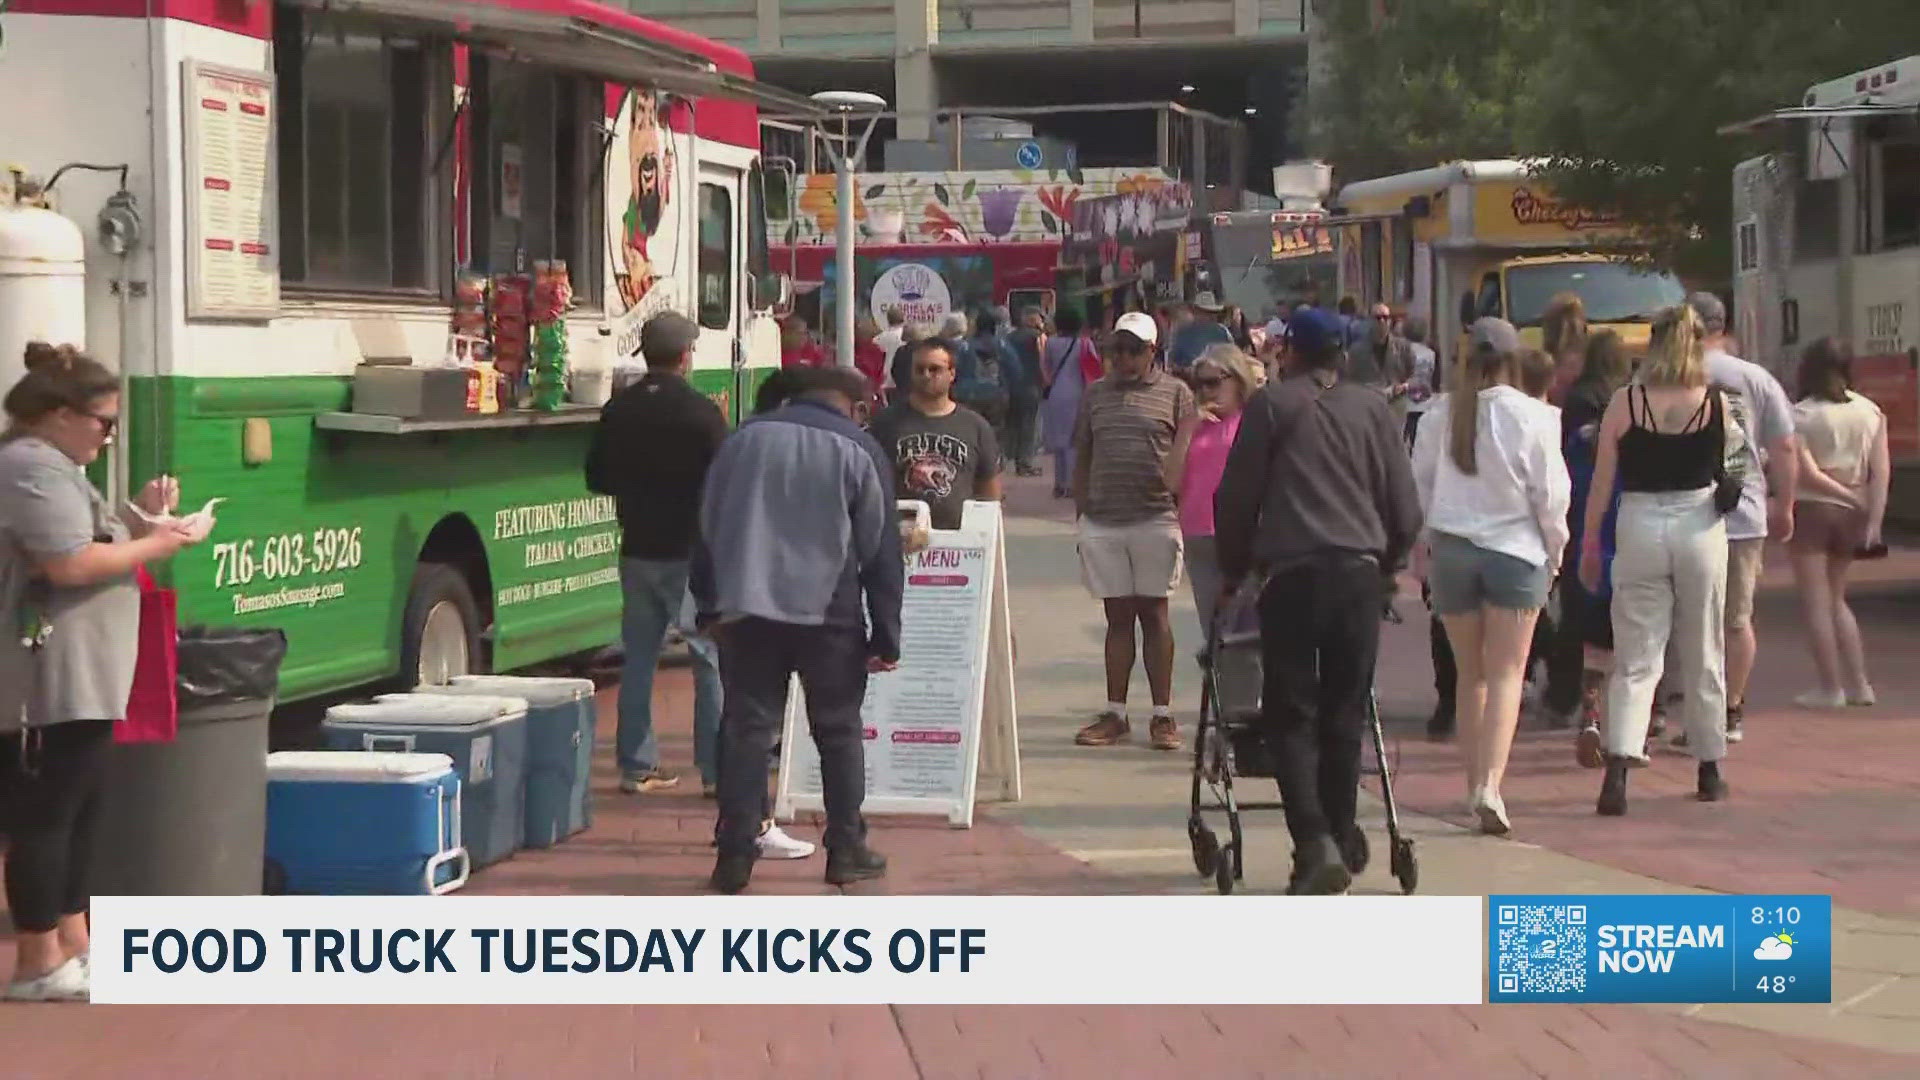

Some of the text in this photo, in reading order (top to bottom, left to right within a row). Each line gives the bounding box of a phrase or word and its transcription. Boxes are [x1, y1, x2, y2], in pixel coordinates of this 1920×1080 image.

[896, 433, 969, 466] RIT
[494, 501, 566, 540] FEATURING
[213, 527, 362, 588] 716-603-5926
[525, 531, 616, 568] ITALIAN CHICKEN
[917, 549, 961, 568] MENU
